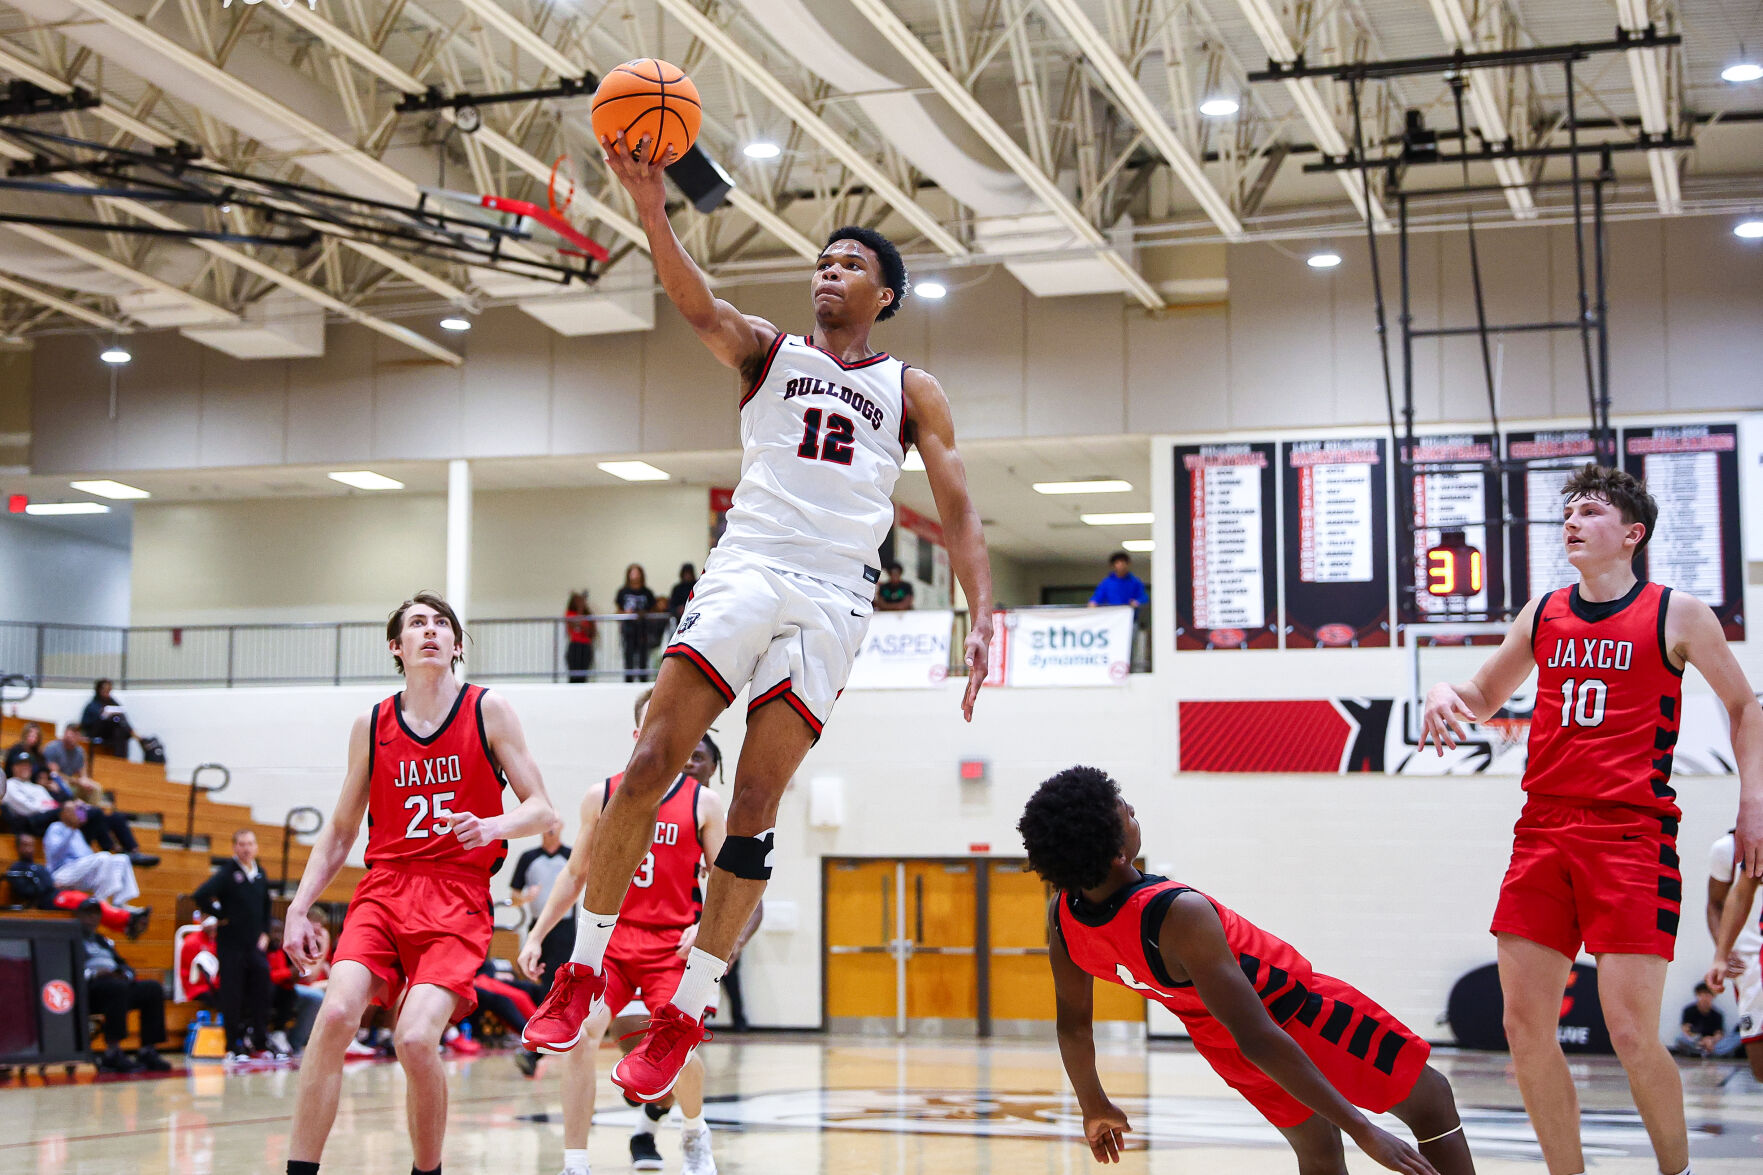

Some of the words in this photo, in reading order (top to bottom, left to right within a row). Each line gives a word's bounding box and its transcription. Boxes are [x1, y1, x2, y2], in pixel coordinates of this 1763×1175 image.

[784, 377, 884, 431] BULLDOGS
[797, 407, 856, 466] 12
[1428, 550, 1481, 593] 31
[866, 634, 946, 654] ASPEN
[1029, 654, 1109, 669] dynamics
[1547, 637, 1633, 671] JAXCO
[1560, 678, 1608, 728] 10
[394, 754, 462, 788] JAXCO
[404, 791, 455, 839] 25
